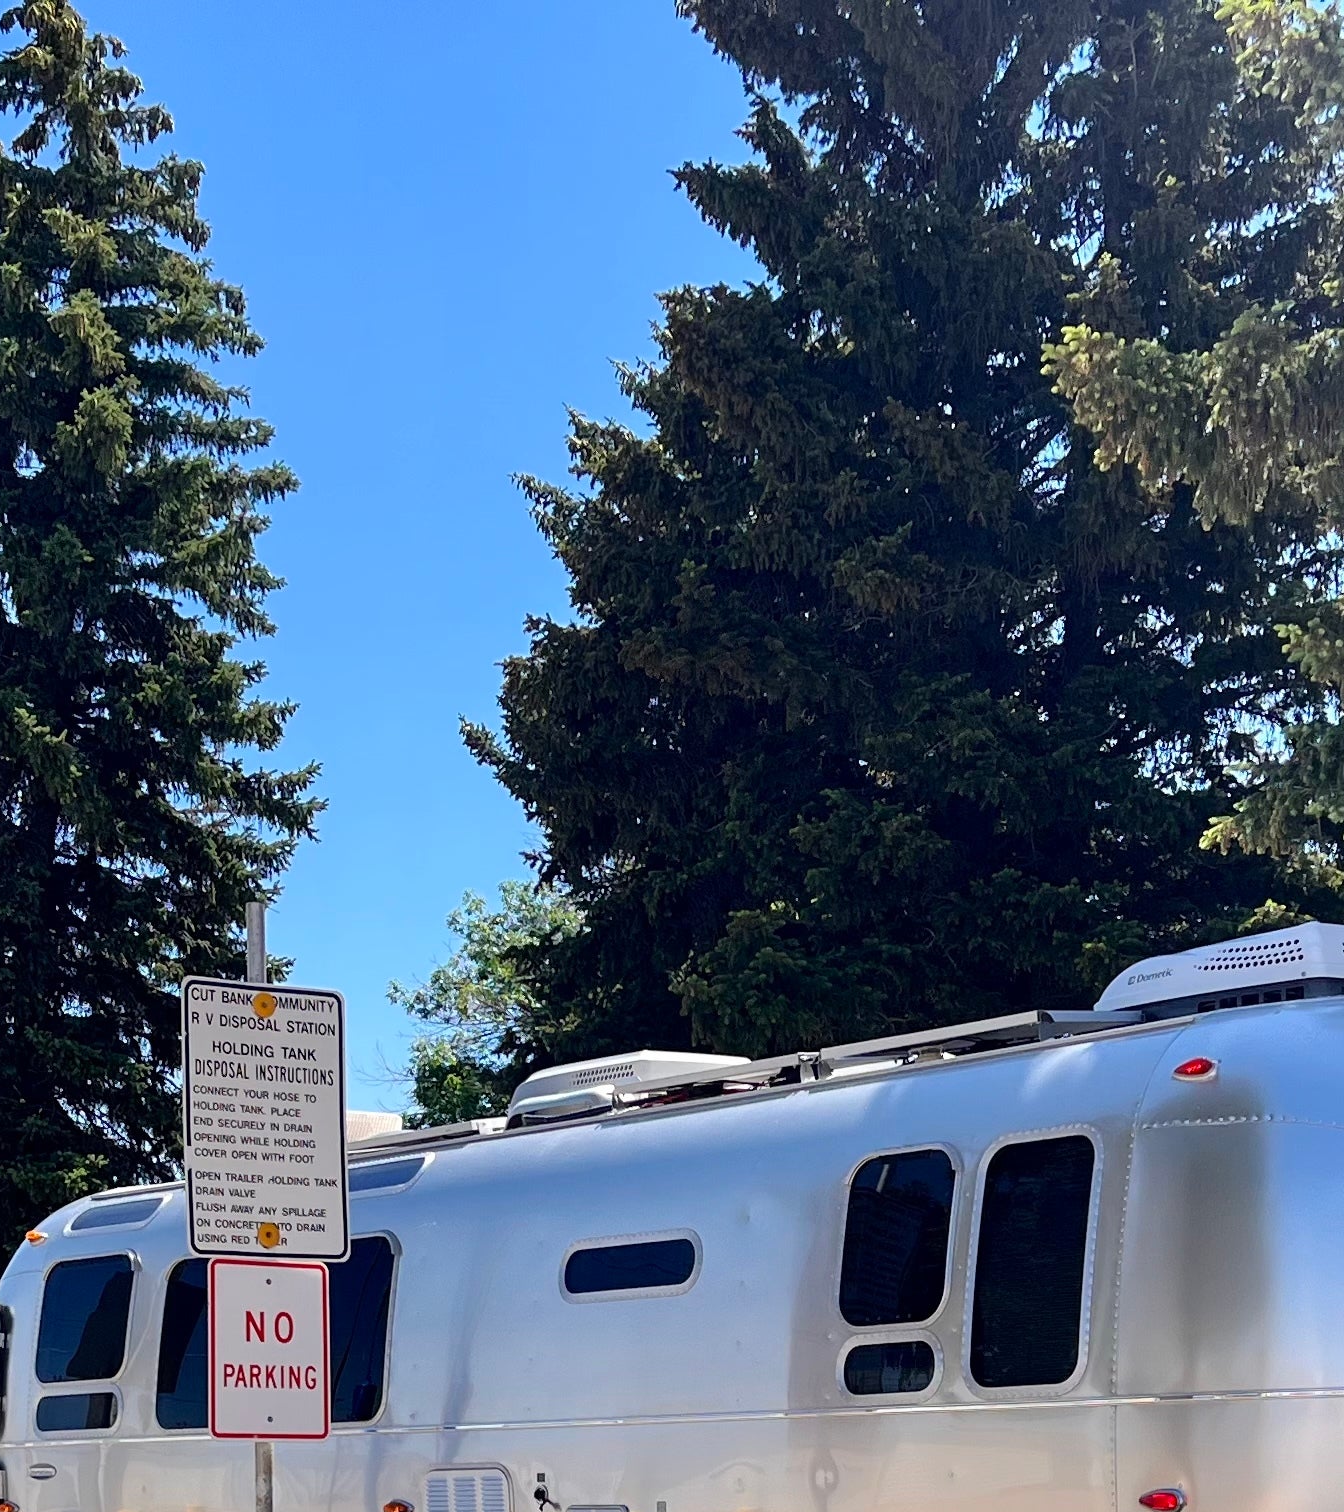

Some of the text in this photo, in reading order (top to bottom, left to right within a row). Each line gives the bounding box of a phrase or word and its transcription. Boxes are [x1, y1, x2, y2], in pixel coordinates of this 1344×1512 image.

[191, 987, 335, 1013] CUT BANK MMUNITY
[192, 1012, 336, 1036] R V DISPOSAL STATION
[212, 1040, 317, 1062] HOLDING TANK
[195, 1058, 334, 1087] DISPOSAL INSTRUCTIONS
[193, 1084, 317, 1104] CONNECT YOUR HOSE TO
[193, 1100, 236, 1113] HOLDING
[270, 1107, 301, 1118] PLACE
[193, 1116, 313, 1134] END SECURELY IN DRAIN
[193, 1132, 317, 1149] OPENING WHILE HOLDING
[194, 1147, 315, 1164] COVER OPEN WITH FOOT
[195, 1170, 339, 1188] OPEN TRAILER HOLDING TANK
[195, 1186, 256, 1198] DRAIN VALVE
[195, 1201, 327, 1218] FLUSH AWAY ANY SPILLAGE
[196, 1218, 326, 1233] ON CONCRET NTO DRAIN
[197, 1233, 227, 1244] USING
[231, 1235, 250, 1245] RED
[245, 1310, 294, 1344] NO
[223, 1363, 317, 1390] PARKING
